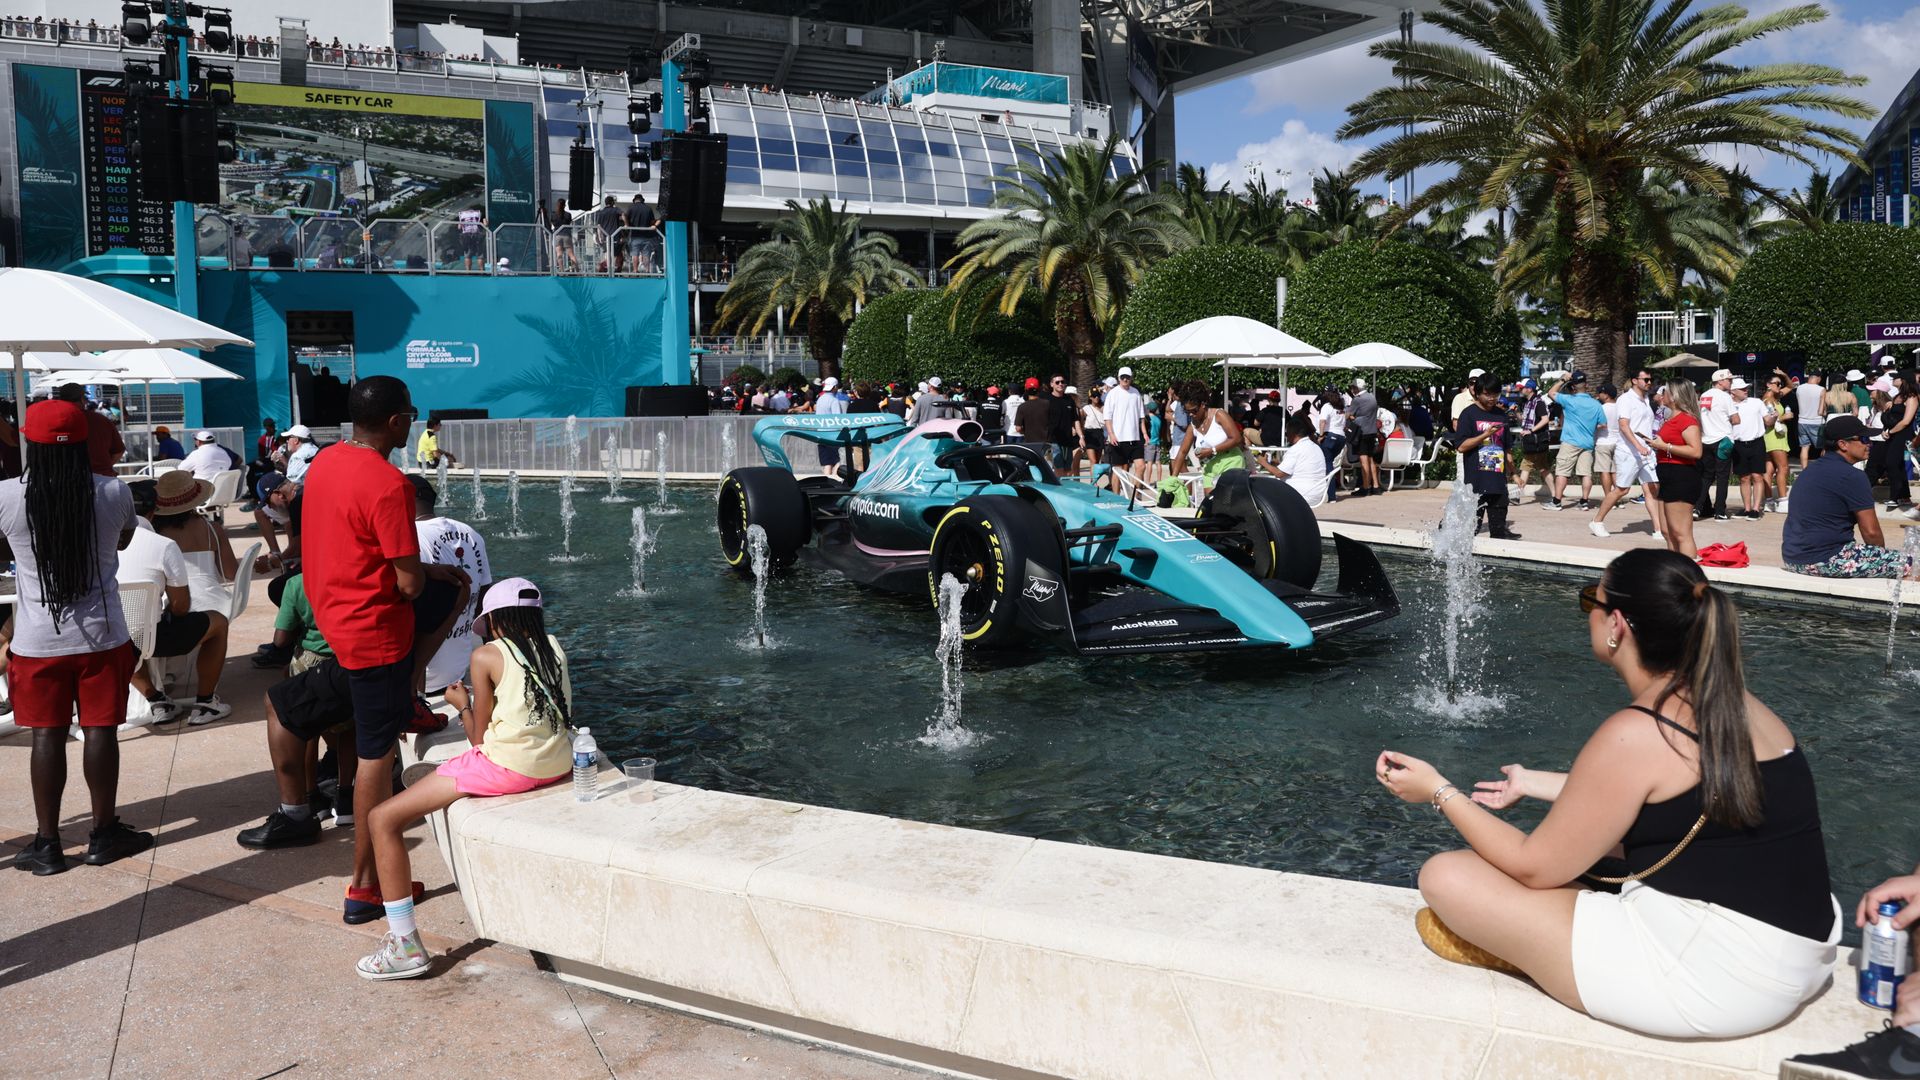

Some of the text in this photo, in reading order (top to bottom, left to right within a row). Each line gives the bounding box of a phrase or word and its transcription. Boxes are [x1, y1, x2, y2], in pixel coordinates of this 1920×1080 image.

[982, 75, 1027, 92] Miami
[102, 97, 126, 105] NOR
[305, 93, 393, 108] SAFETY CAR
[103, 107, 124, 115] VER
[104, 146, 125, 154] PER
[105, 156, 126, 164] TSU
[106, 166, 131, 174] HAM
[106, 176, 127, 184] RUS
[1876, 193, 1885, 218] LIQUID
[108, 225, 130, 233] ZHO
[109, 235, 125, 243] RIC
[801, 414, 887, 428] crypto.com
[1142, 520, 1171, 530] 05
[439, 530, 470, 544] street
[1155, 529, 1185, 539] 24
[981, 520, 1004, 593] P ZERO
[1111, 618, 1178, 631] AutoNation
[1109, 641, 1185, 650] INTERNATIONAL
[1188, 636, 1248, 645] AUTODROME
